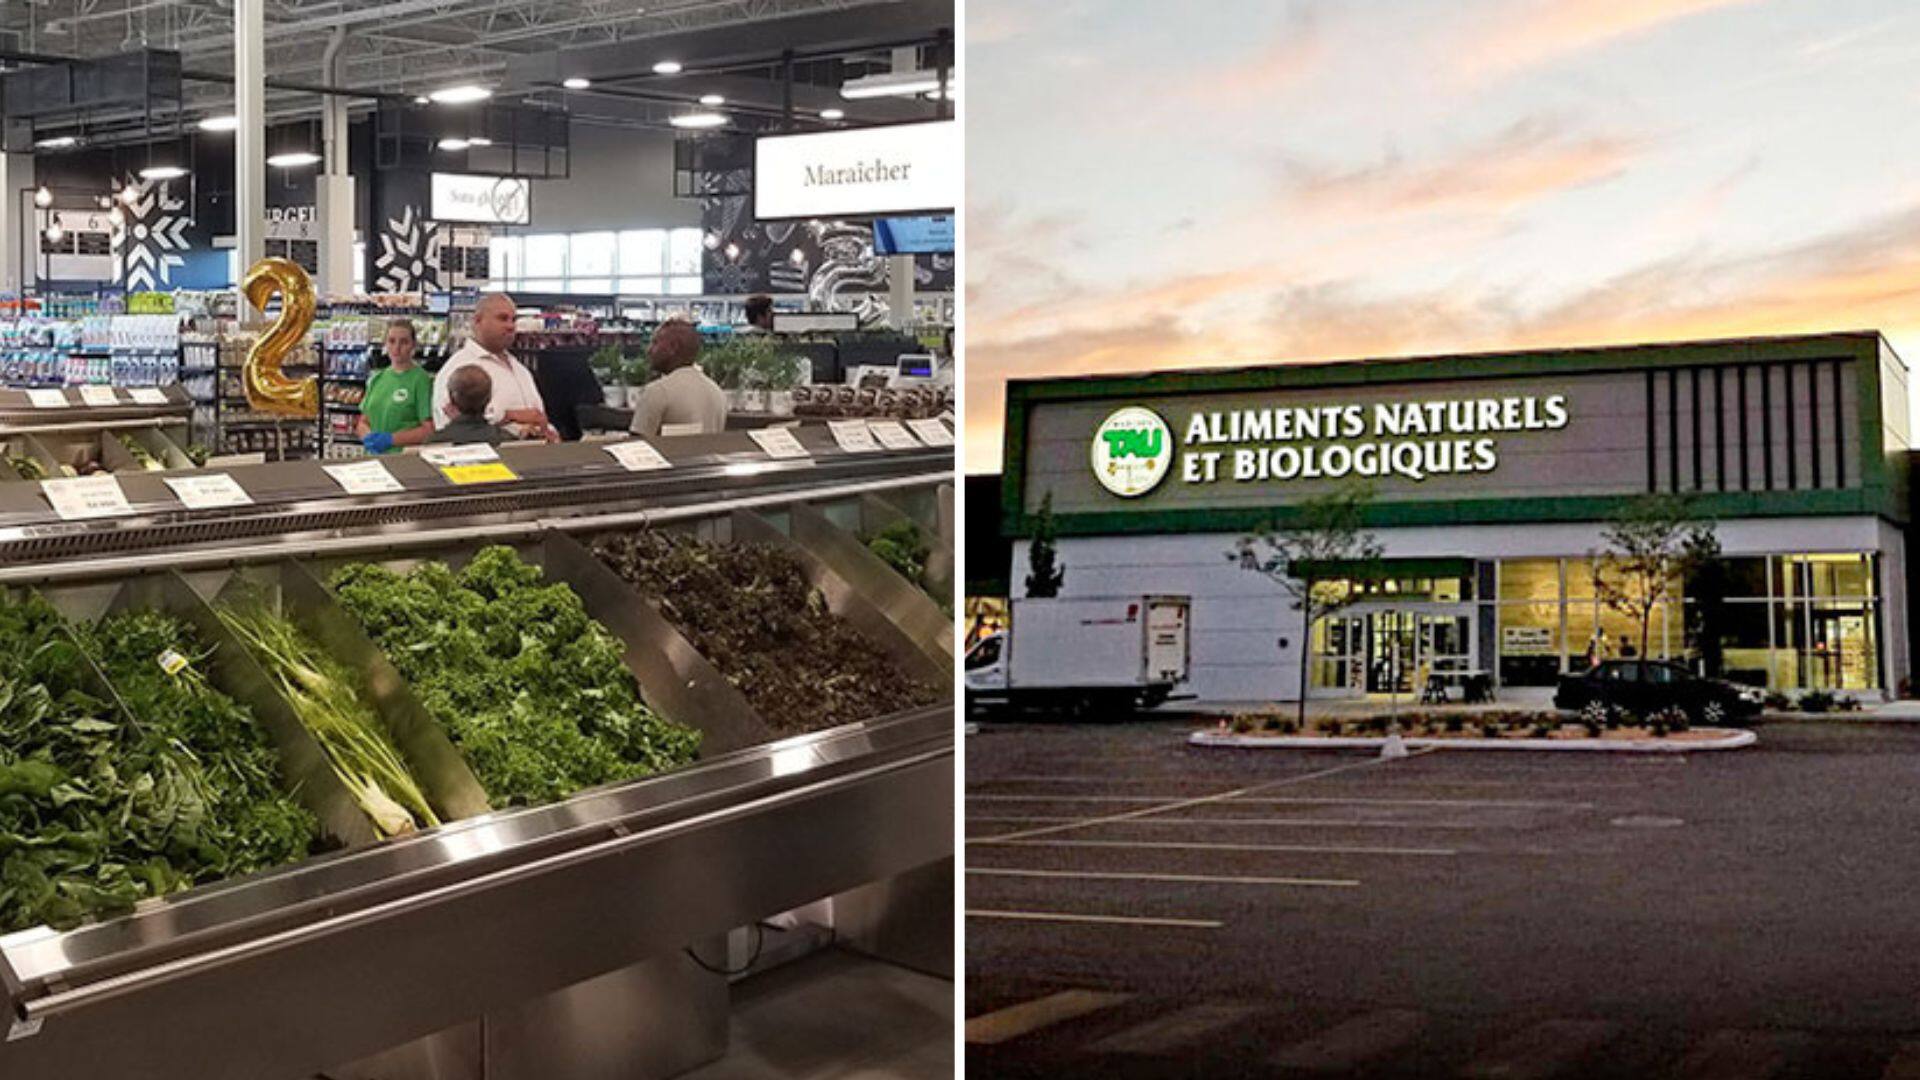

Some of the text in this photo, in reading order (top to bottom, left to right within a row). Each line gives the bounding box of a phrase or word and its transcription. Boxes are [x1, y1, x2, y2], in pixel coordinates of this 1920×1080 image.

[88, 211, 98, 229] 6
[1184, 394, 1568, 444] ALIMENTS NATURELS
[1102, 427, 1163, 459] TAU
[1182, 438, 1497, 483] ET BIOLOGIQUES
